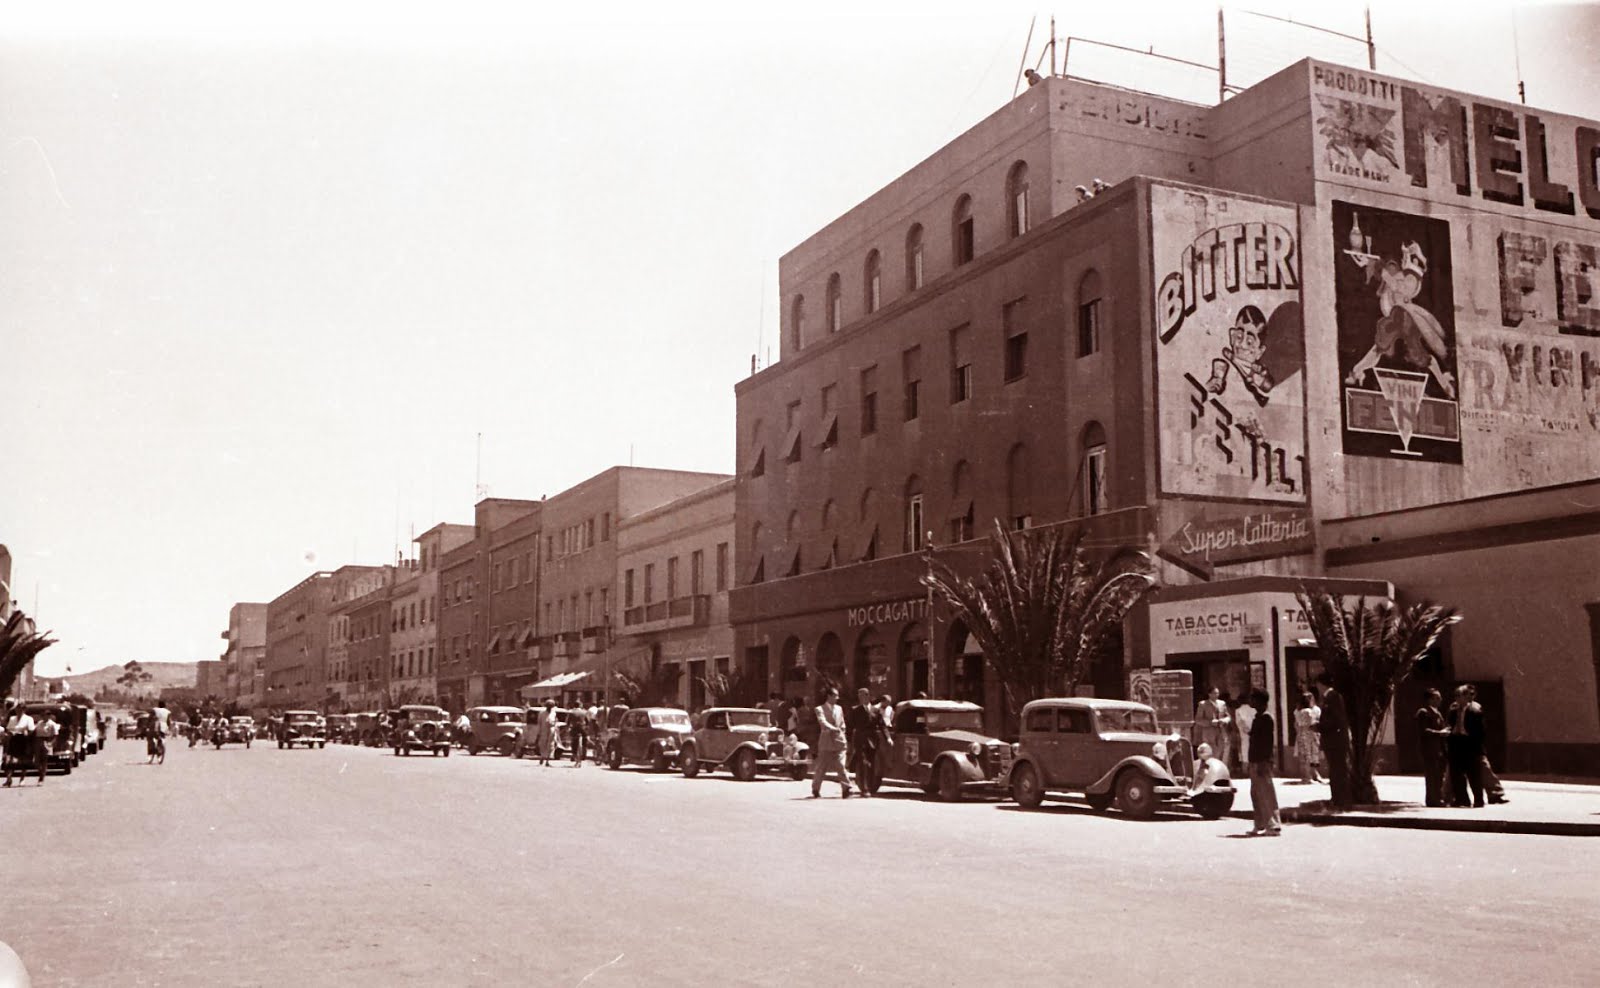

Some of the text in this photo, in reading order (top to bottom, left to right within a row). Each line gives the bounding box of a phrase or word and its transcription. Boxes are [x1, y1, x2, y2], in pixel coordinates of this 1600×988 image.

[1158, 222, 1299, 345] BITTER
[1386, 383, 1418, 398] VINI
[1181, 522, 1238, 562] Super
[1165, 612, 1247, 631] TABACCHI
